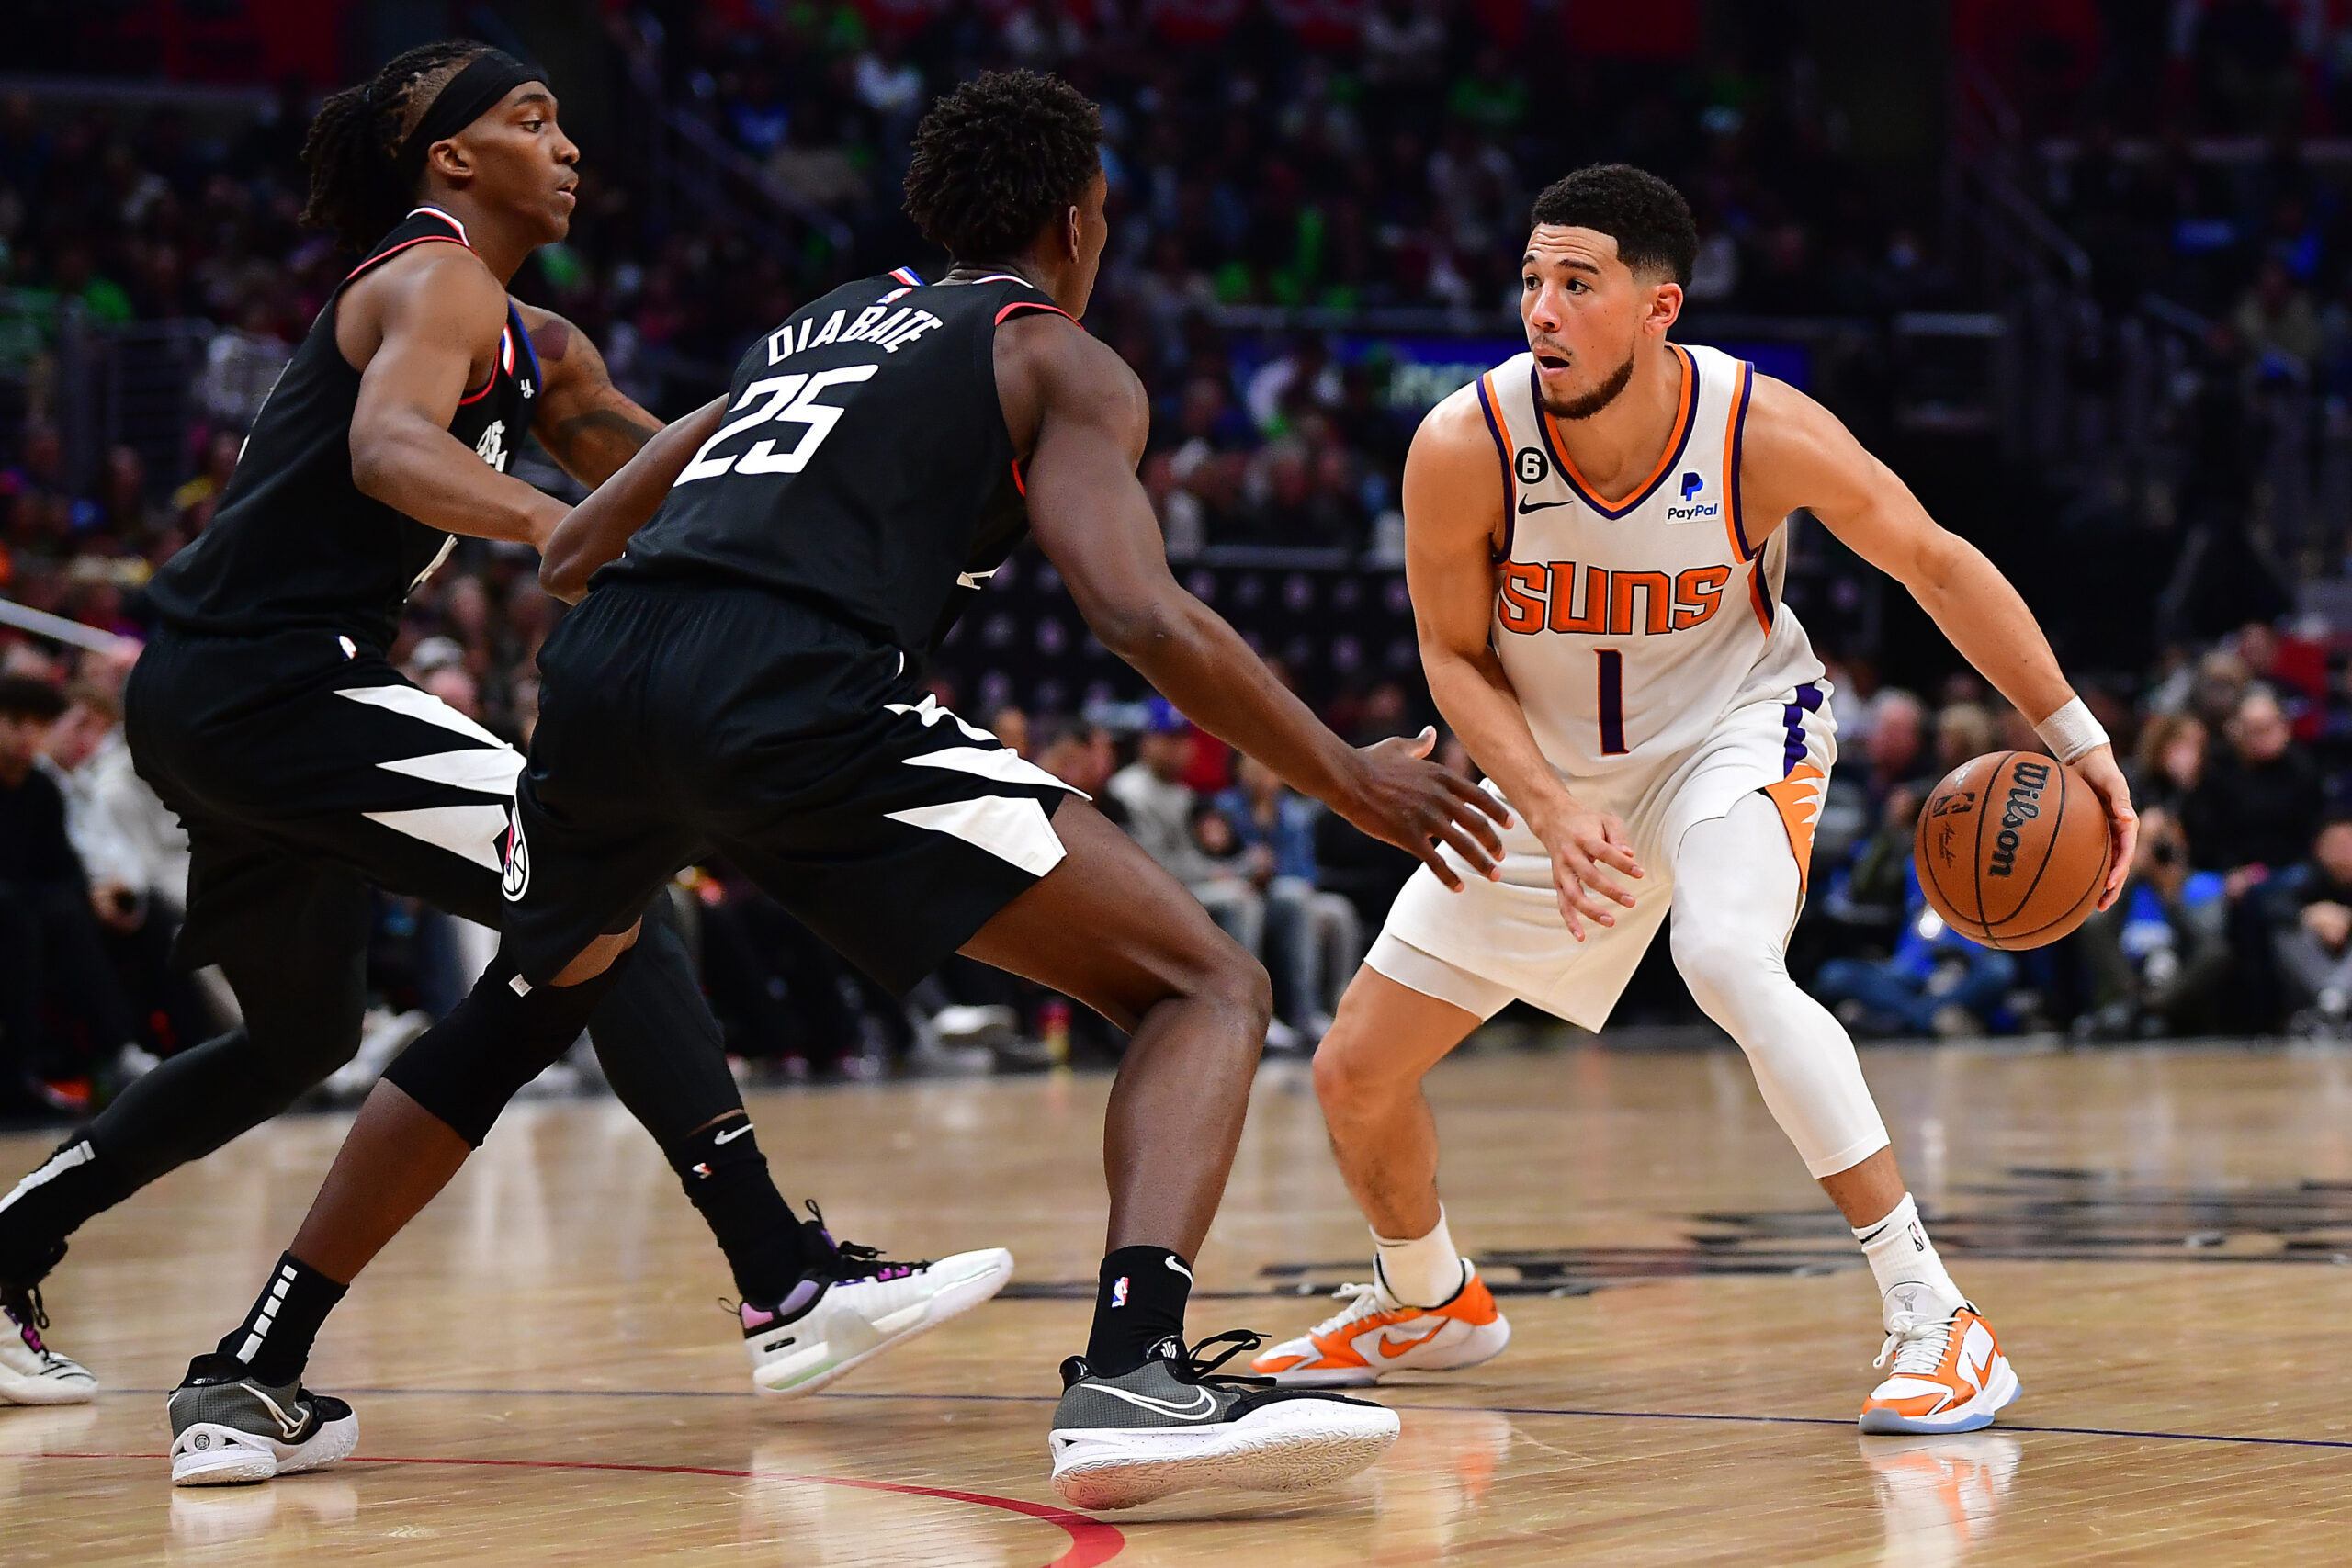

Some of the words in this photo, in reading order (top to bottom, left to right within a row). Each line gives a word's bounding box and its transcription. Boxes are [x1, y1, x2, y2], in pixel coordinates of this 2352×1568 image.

[768, 306, 943, 366] DIABATE
[673, 364, 879, 487] 25
[1522, 453, 1541, 479] 6
[1668, 503, 1718, 520] PayPal
[1593, 648, 1630, 756] 1
[1988, 761, 2052, 878] Wilson
